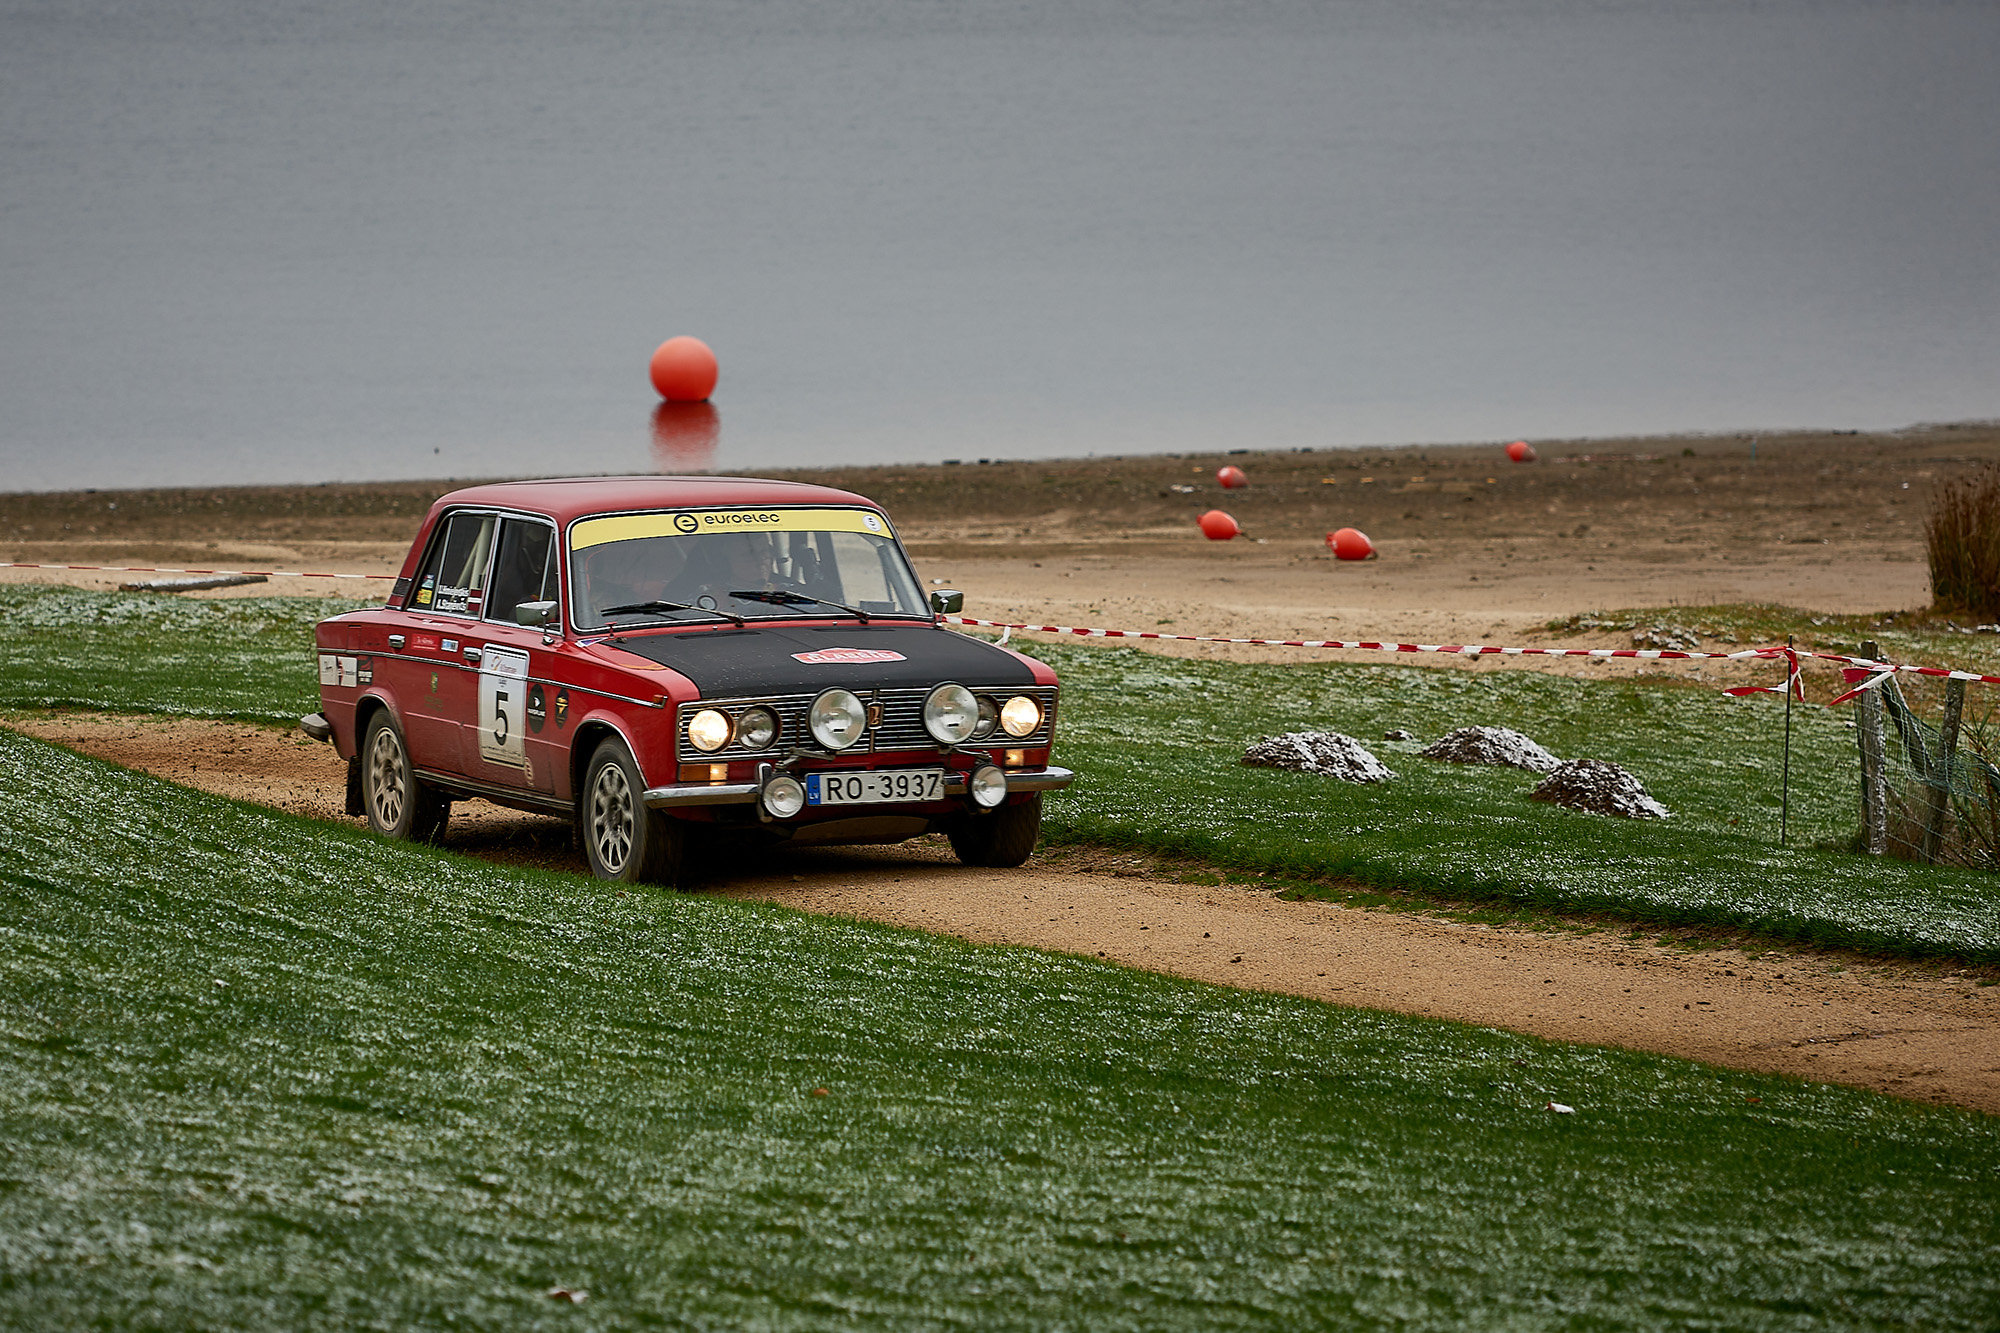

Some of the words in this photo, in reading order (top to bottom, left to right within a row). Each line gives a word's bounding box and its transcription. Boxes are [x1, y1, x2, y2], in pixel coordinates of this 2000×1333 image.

[704, 514, 780, 524] euroelec
[494, 691, 509, 746] 5
[808, 792, 820, 800] LV
[827, 774, 940, 801] RO-3937
